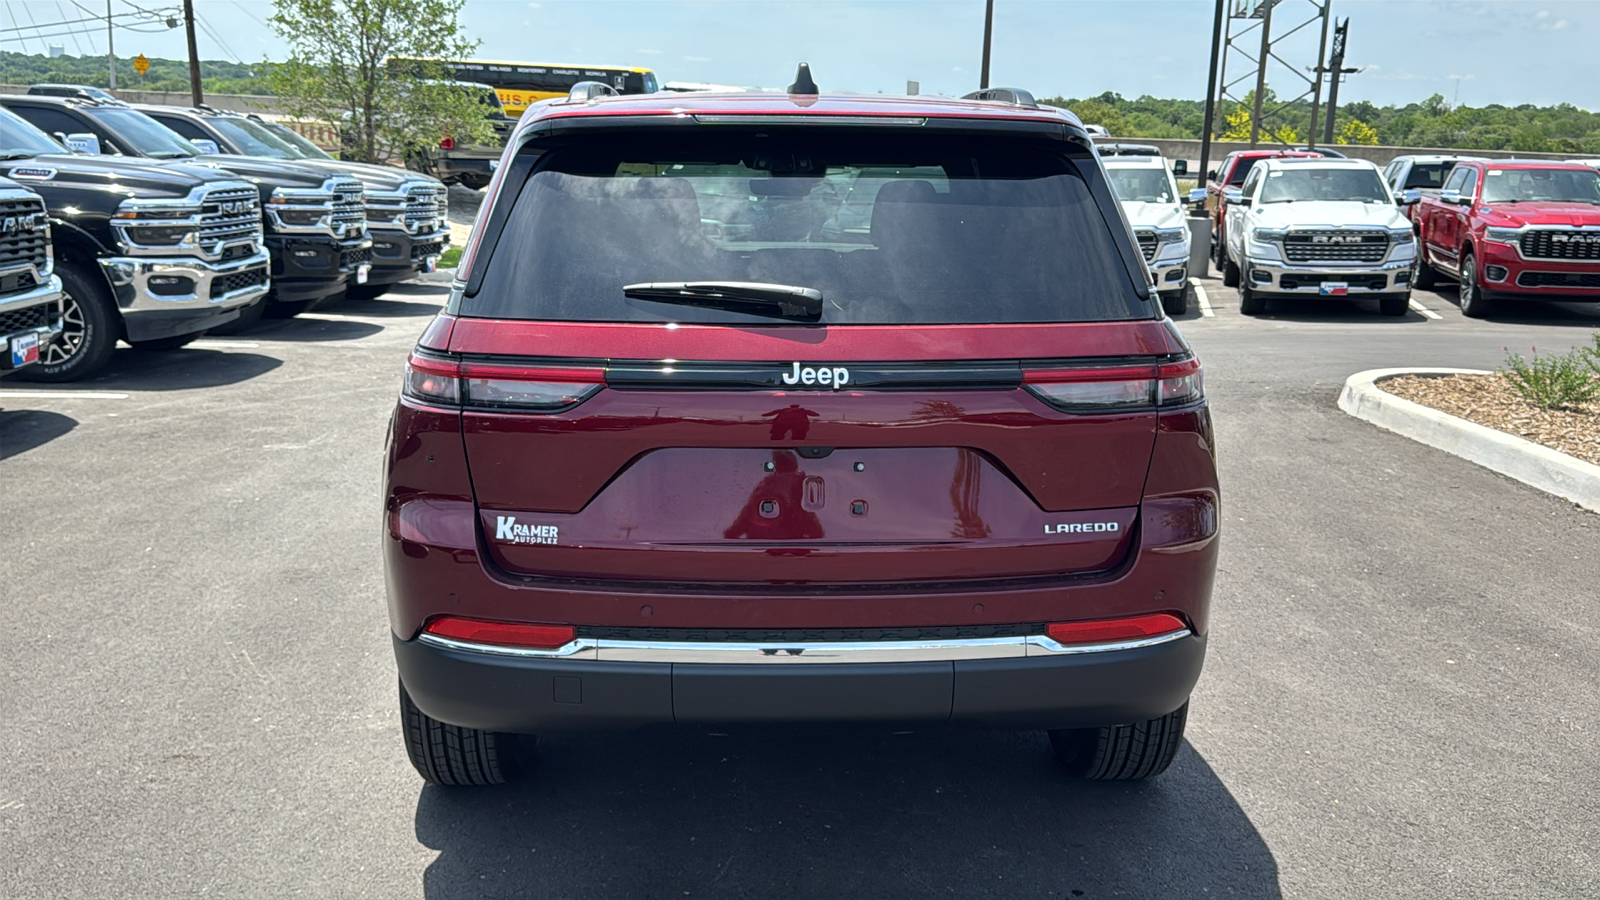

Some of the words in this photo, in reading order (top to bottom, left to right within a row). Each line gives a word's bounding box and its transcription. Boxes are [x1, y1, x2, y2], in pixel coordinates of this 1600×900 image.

[223, 201, 253, 214] RAM
[0, 216, 35, 234] AM
[1551, 234, 1600, 243] RAM
[782, 362, 849, 389] Jeep
[496, 516, 558, 539] KRAMER
[1044, 522, 1119, 534] LAREDO
[514, 536, 558, 544] AUTOPLEX
